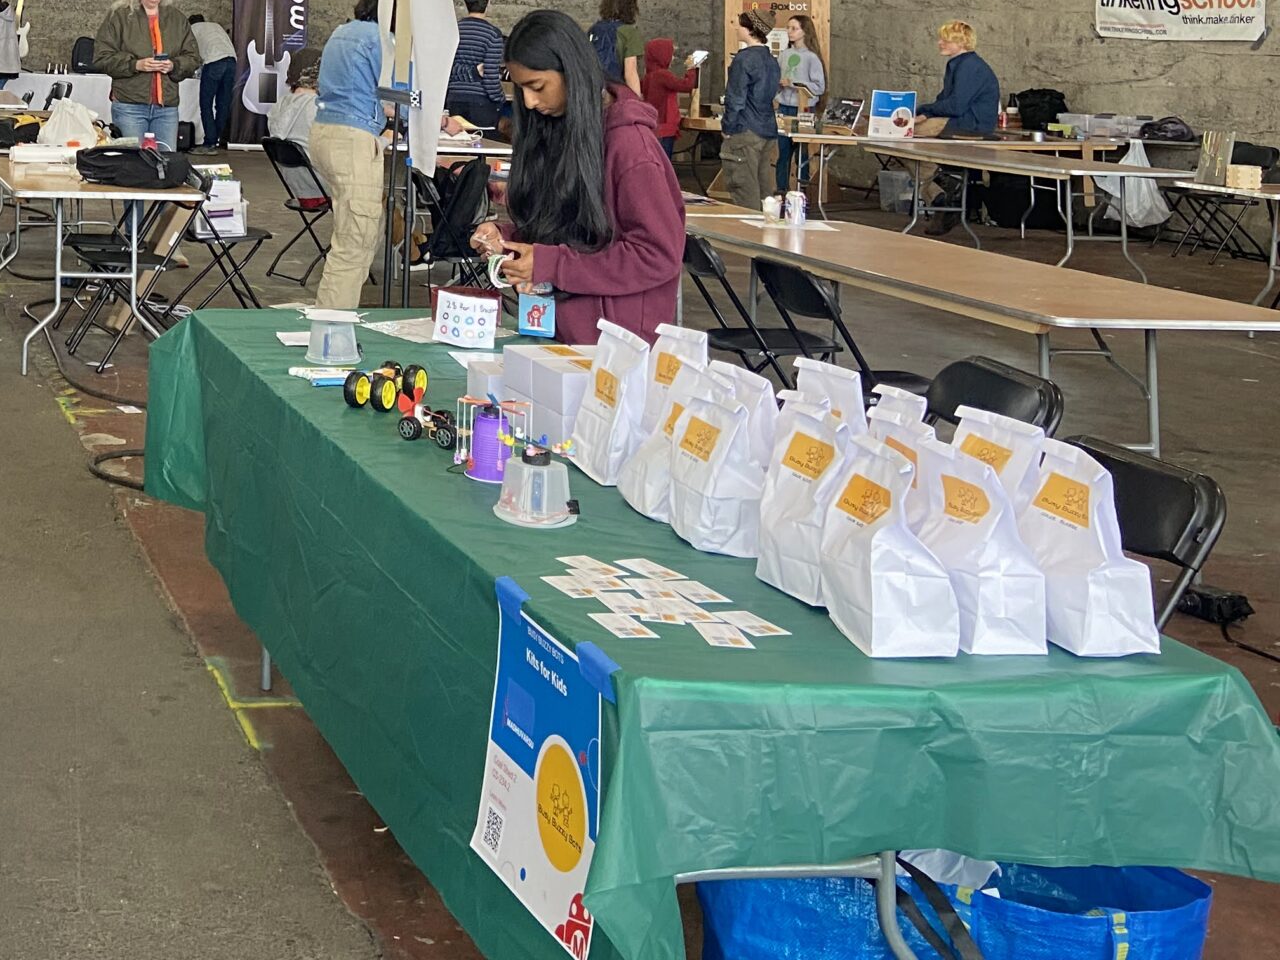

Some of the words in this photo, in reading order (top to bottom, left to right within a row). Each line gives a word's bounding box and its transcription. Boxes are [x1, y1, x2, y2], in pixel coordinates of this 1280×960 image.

[770, 2, 807, 11] Boxbot
[526, 647, 539, 672] Kits
[540, 661, 551, 681] for
[551, 670, 567, 697] Kids
